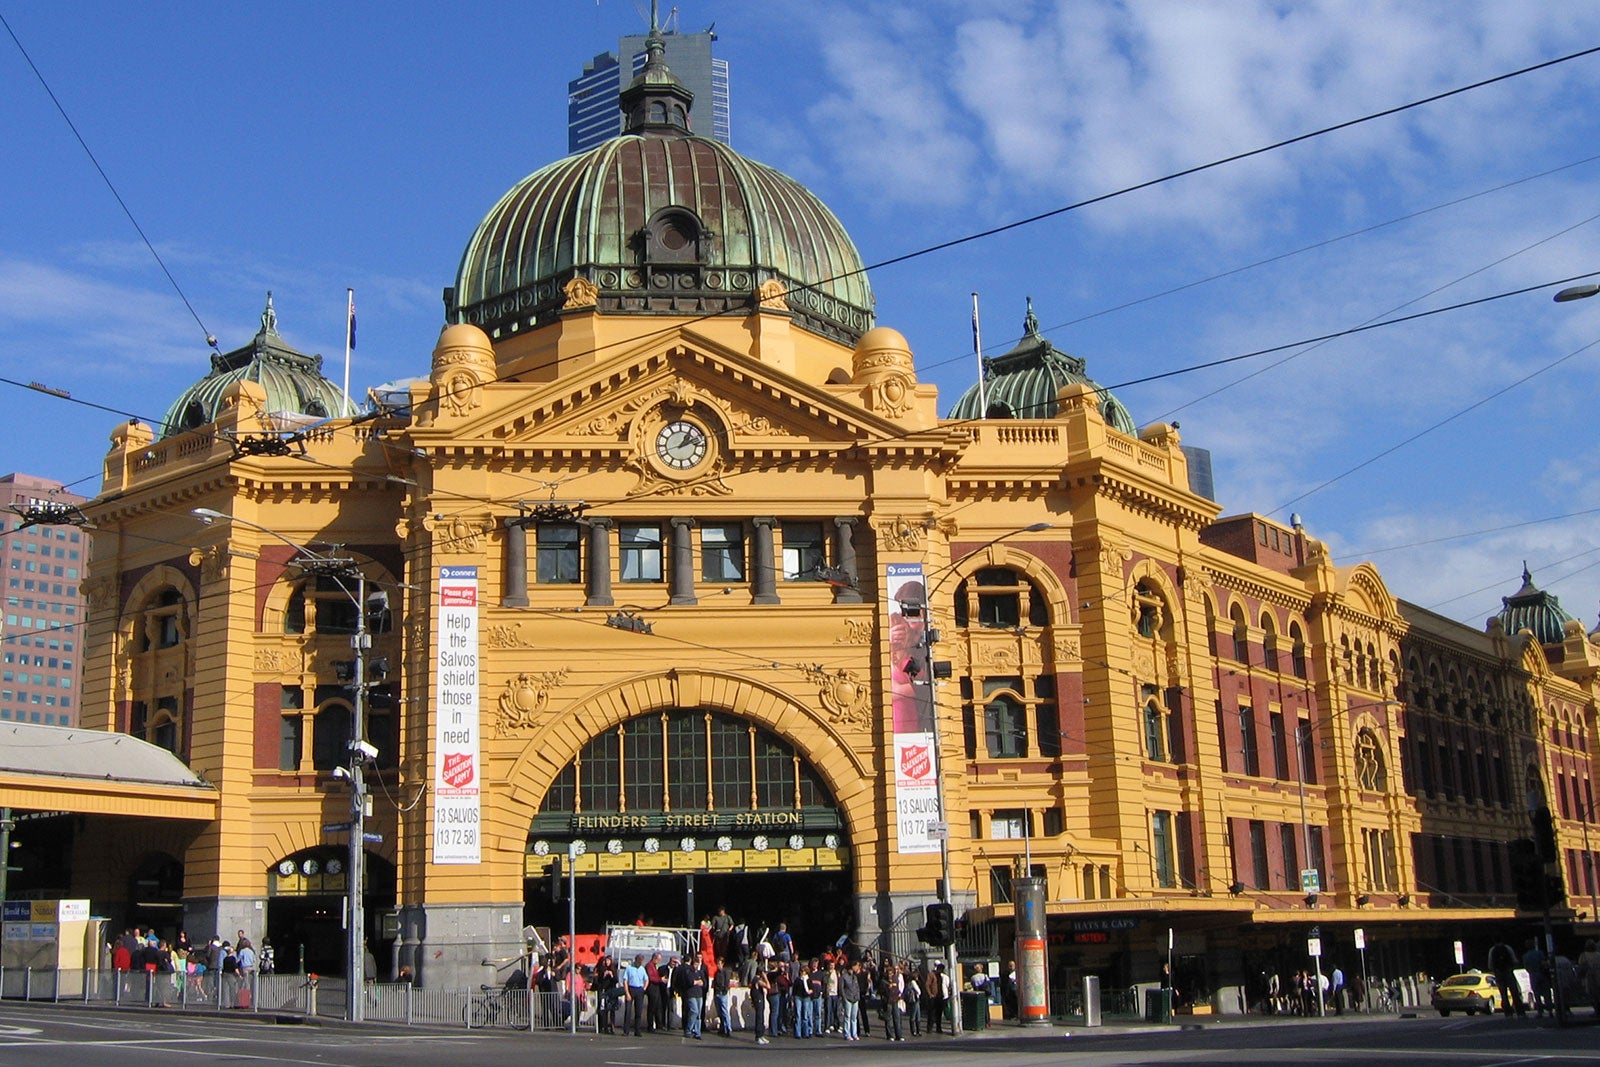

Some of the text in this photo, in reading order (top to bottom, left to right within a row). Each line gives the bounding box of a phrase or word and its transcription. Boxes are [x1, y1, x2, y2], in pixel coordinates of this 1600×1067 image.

[446, 613, 470, 632] Help
[450, 632, 467, 648] the
[440, 650, 476, 668] Salvos
[443, 670, 475, 687] shield
[442, 690, 472, 706] those
[452, 708, 462, 724] in
[444, 728, 470, 744] need
[448, 754, 462, 768] THE
[902, 748, 929, 773] SALVATION
[905, 746, 916, 759] THE
[444, 756, 472, 781] SALVATION
[453, 768, 471, 786] ARMY
[912, 759, 928, 778] ARMY
[898, 797, 939, 814] 13 SALVOS
[437, 808, 478, 824] 13 SALVOS
[578, 812, 799, 828] FLINDERS STREET STATION
[901, 819, 924, 837] (13 72
[437, 828, 476, 847] (13 72 58)
[1074, 922, 1098, 930] HATS
[1111, 920, 1134, 928] CAPS
